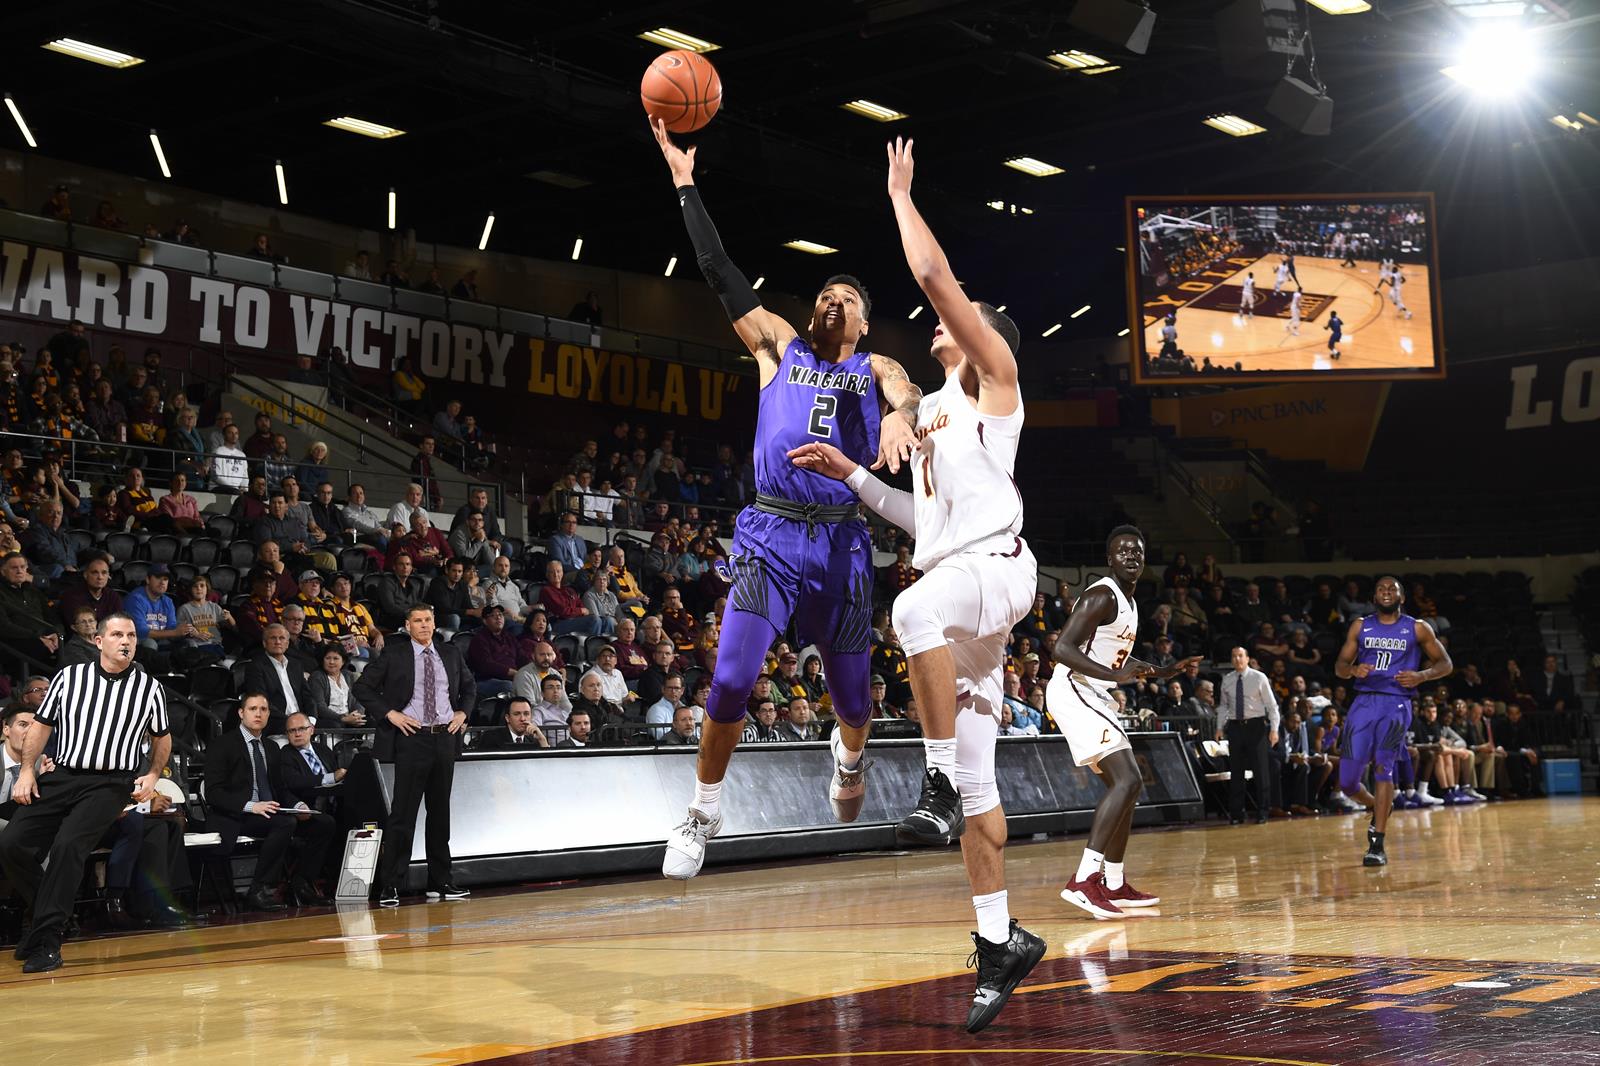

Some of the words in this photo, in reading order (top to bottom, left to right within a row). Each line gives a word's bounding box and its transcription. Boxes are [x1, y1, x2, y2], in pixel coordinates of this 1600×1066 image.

[190, 276, 270, 349] TO
[290, 294, 514, 388] VICTORY
[528, 338, 688, 416] LOYOLA
[787, 364, 871, 396] NIAGARA
[808, 393, 837, 438] 2
[922, 456, 933, 498] 1
[1365, 637, 1407, 651] NIAGARA
[1375, 651, 1392, 671] 11
